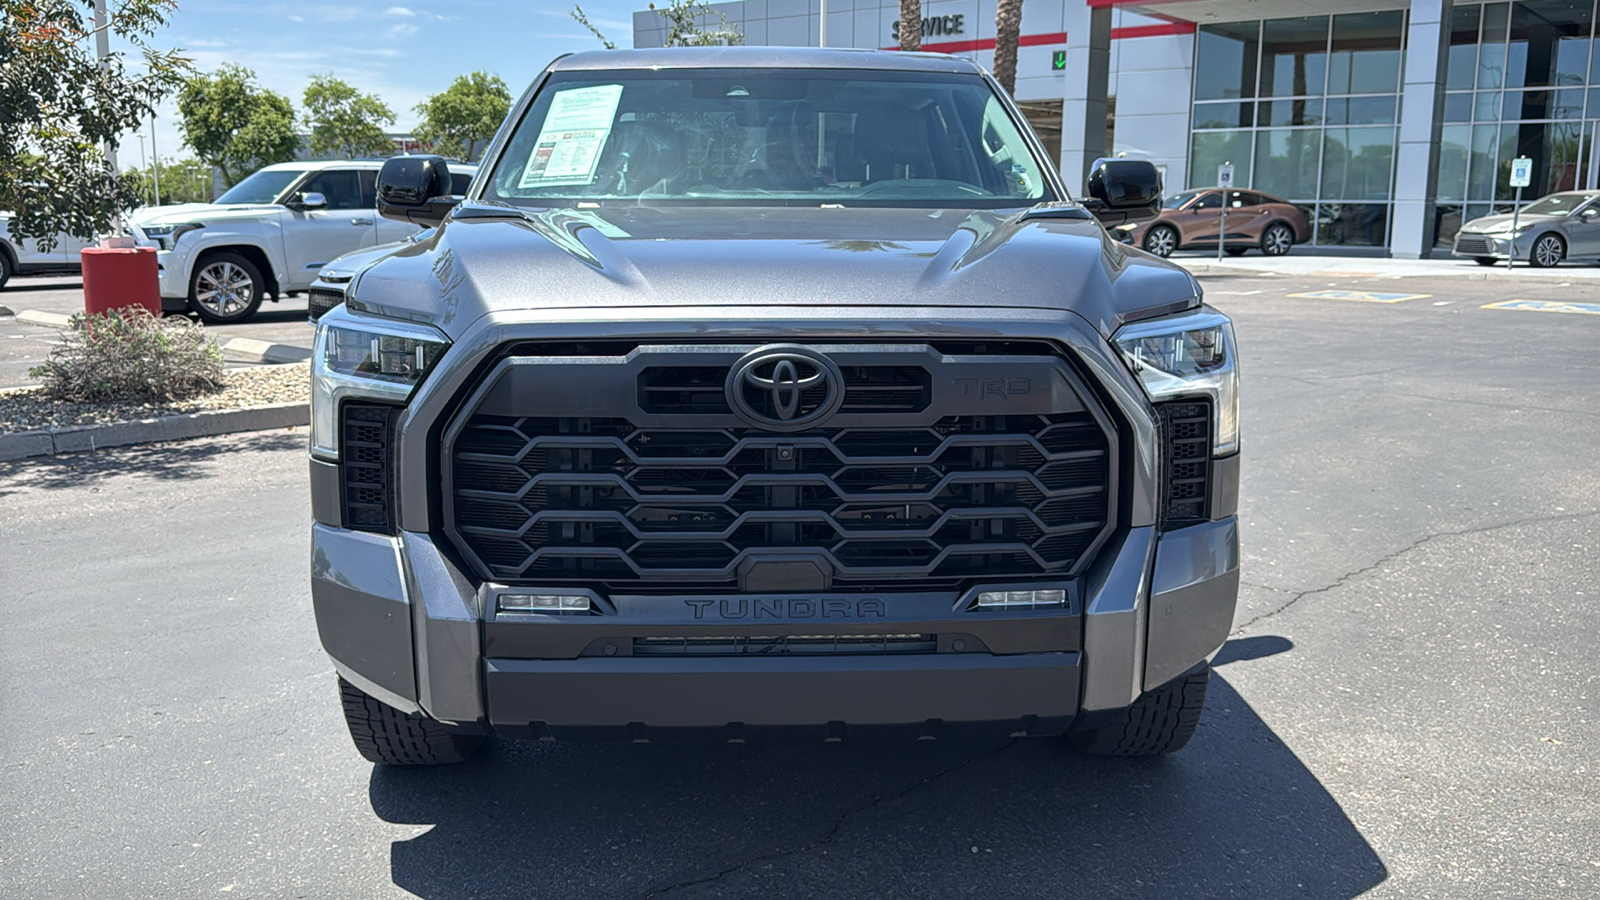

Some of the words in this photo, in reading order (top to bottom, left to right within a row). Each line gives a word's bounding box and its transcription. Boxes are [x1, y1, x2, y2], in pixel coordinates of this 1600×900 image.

[892, 14, 964, 41] SVICE
[952, 378, 1031, 400] TRD
[684, 598, 886, 619] TUNDRA
